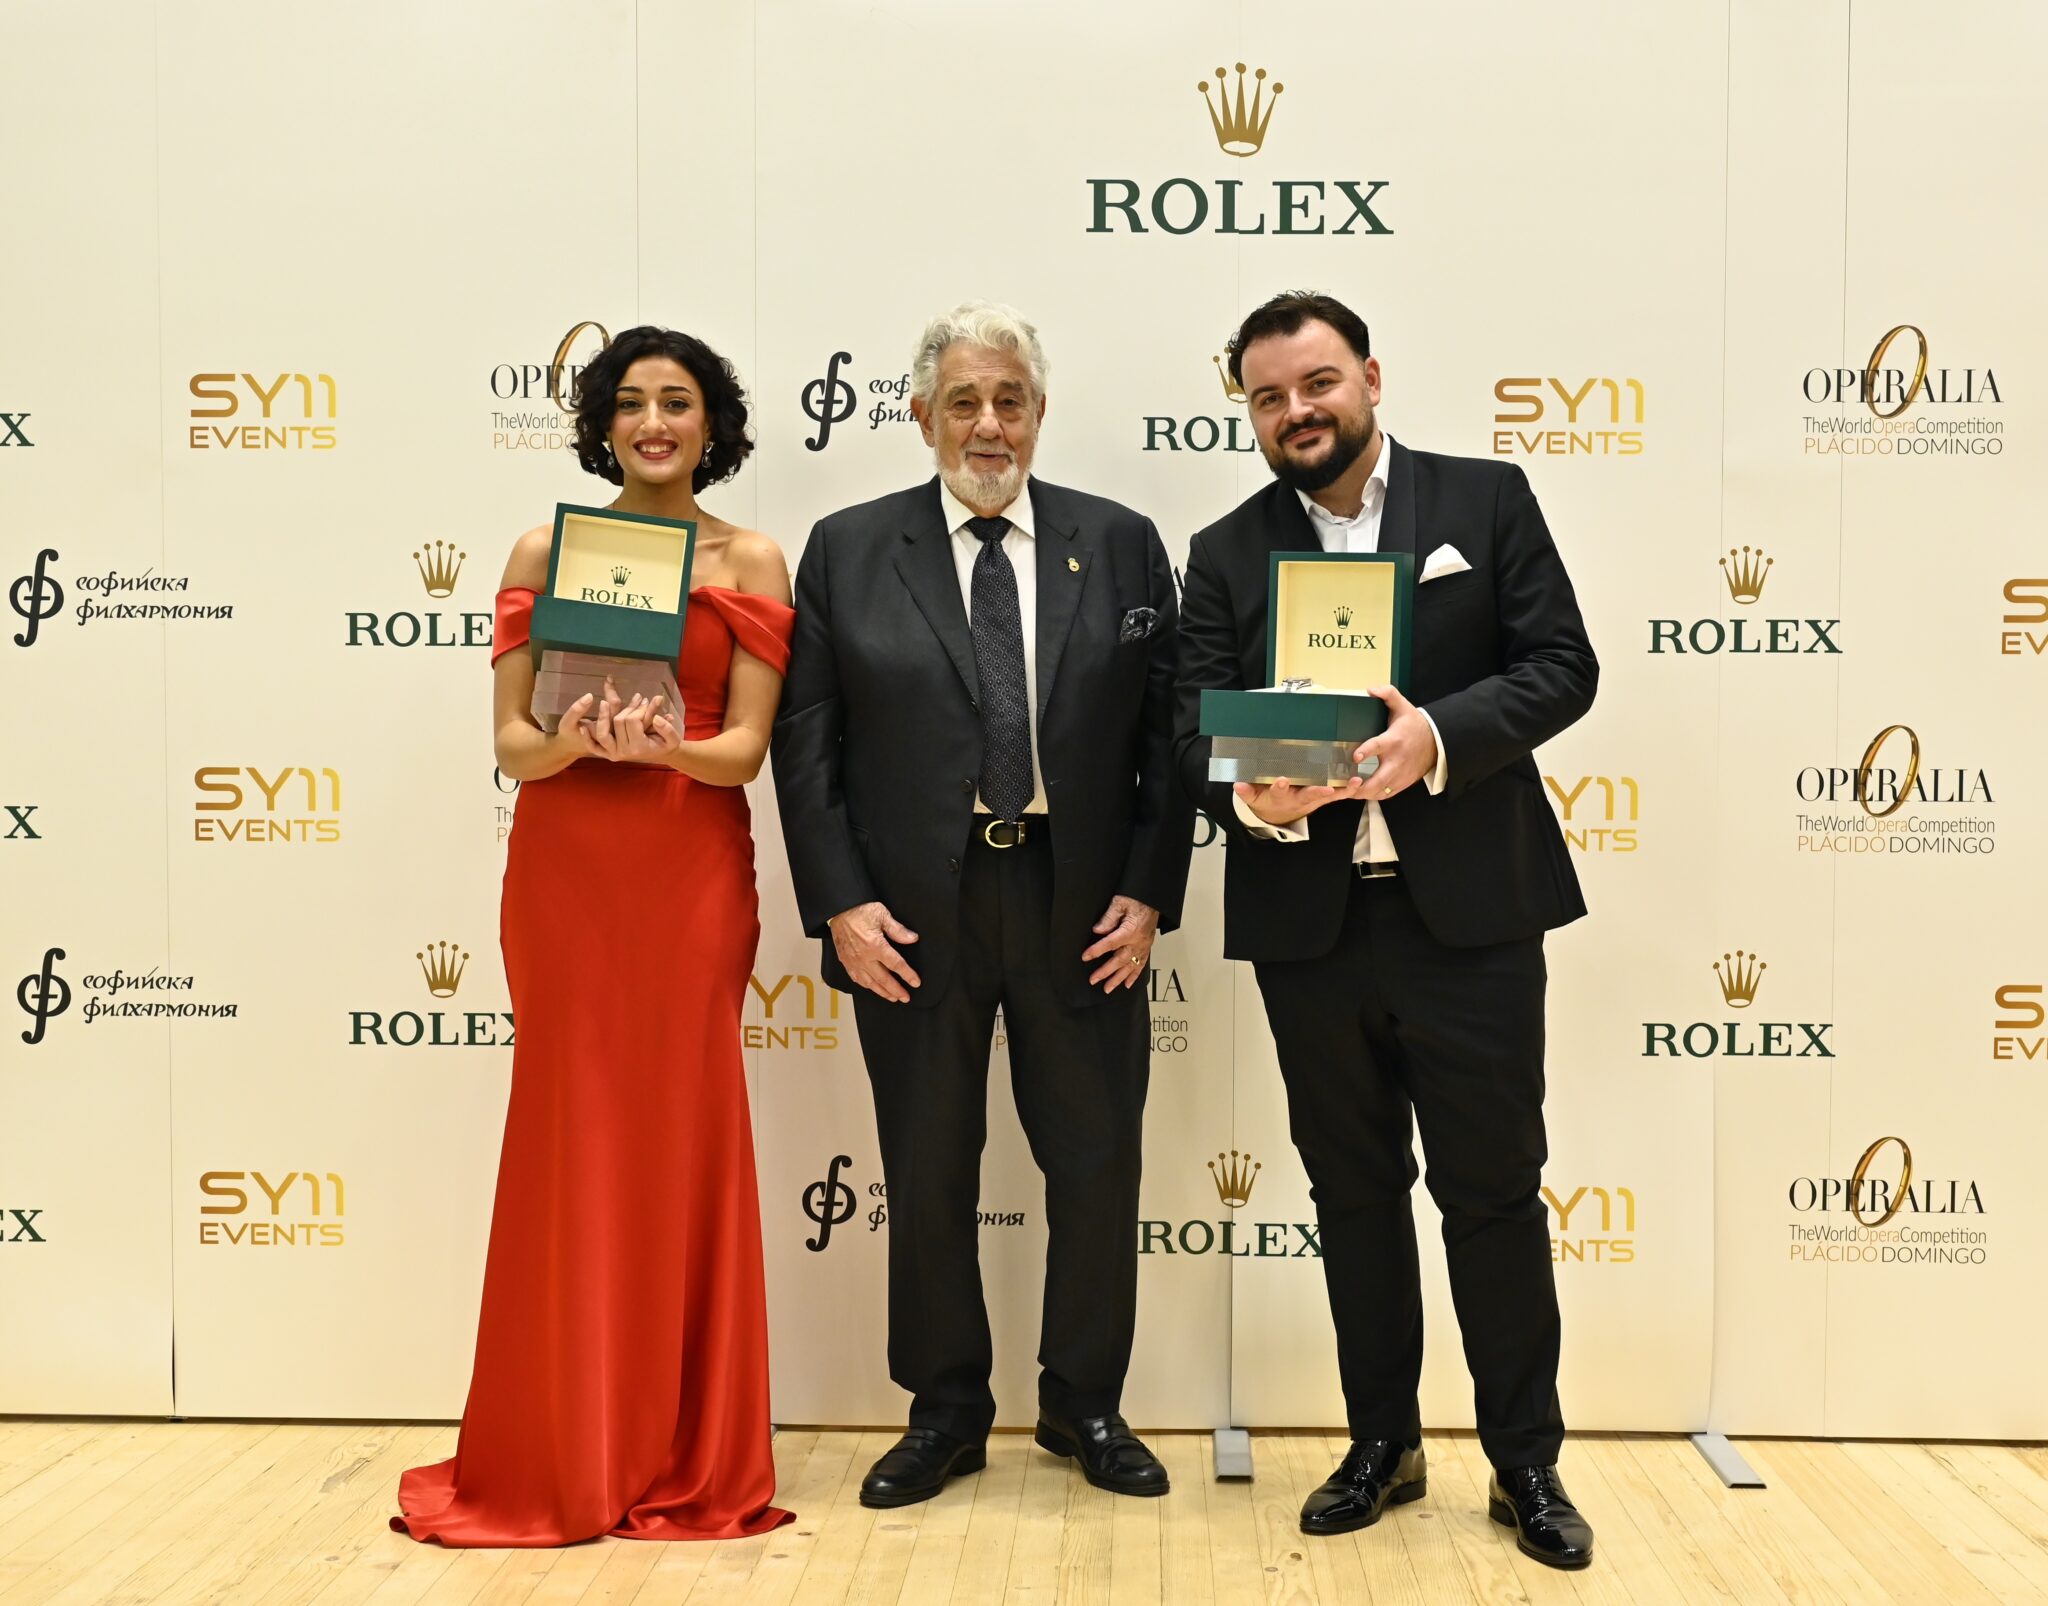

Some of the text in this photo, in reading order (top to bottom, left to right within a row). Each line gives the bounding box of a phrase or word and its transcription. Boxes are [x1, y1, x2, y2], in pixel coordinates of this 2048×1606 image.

[1086, 178, 1394, 235] ROLEX
[189, 373, 336, 418] SY11
[1494, 378, 1645, 424] SY11
[1803, 368, 2004, 403] OPERALIA
[190, 426, 336, 449] EVENTS
[1142, 416, 1255, 452] ROL
[1493, 431, 1643, 455] EVENTS
[1805, 432, 2003, 455] PLÁCIDO DOMINGO
[76, 597, 233, 626] филхармония
[580, 587, 653, 609] ROLEX
[345, 612, 493, 647] ROLE
[1308, 633, 1376, 650] ROLEX
[1648, 618, 1843, 655] ROLEX
[194, 767, 341, 812] SY11
[1543, 776, 1638, 821] Y11
[1796, 767, 1995, 802] OPERALIA
[194, 819, 341, 842] EVENTS
[1564, 829, 1637, 851] NTS
[1798, 832, 1995, 854] PLÁCIDO DOMINGO
[83, 996, 238, 1024] филхармония
[749, 974, 838, 1019] Y11
[742, 1026, 838, 1049] ENTS
[1642, 1022, 1836, 1058] ROLEX
[200, 1171, 345, 1216] SY11
[1540, 1186, 1635, 1231] Y11
[1789, 1177, 1987, 1214] OPERALIA
[200, 1222, 345, 1246] EVENTS
[1138, 1220, 1323, 1257] ROLEX
[1790, 1241, 1986, 1265] PLÁCIDO DOMINGO
